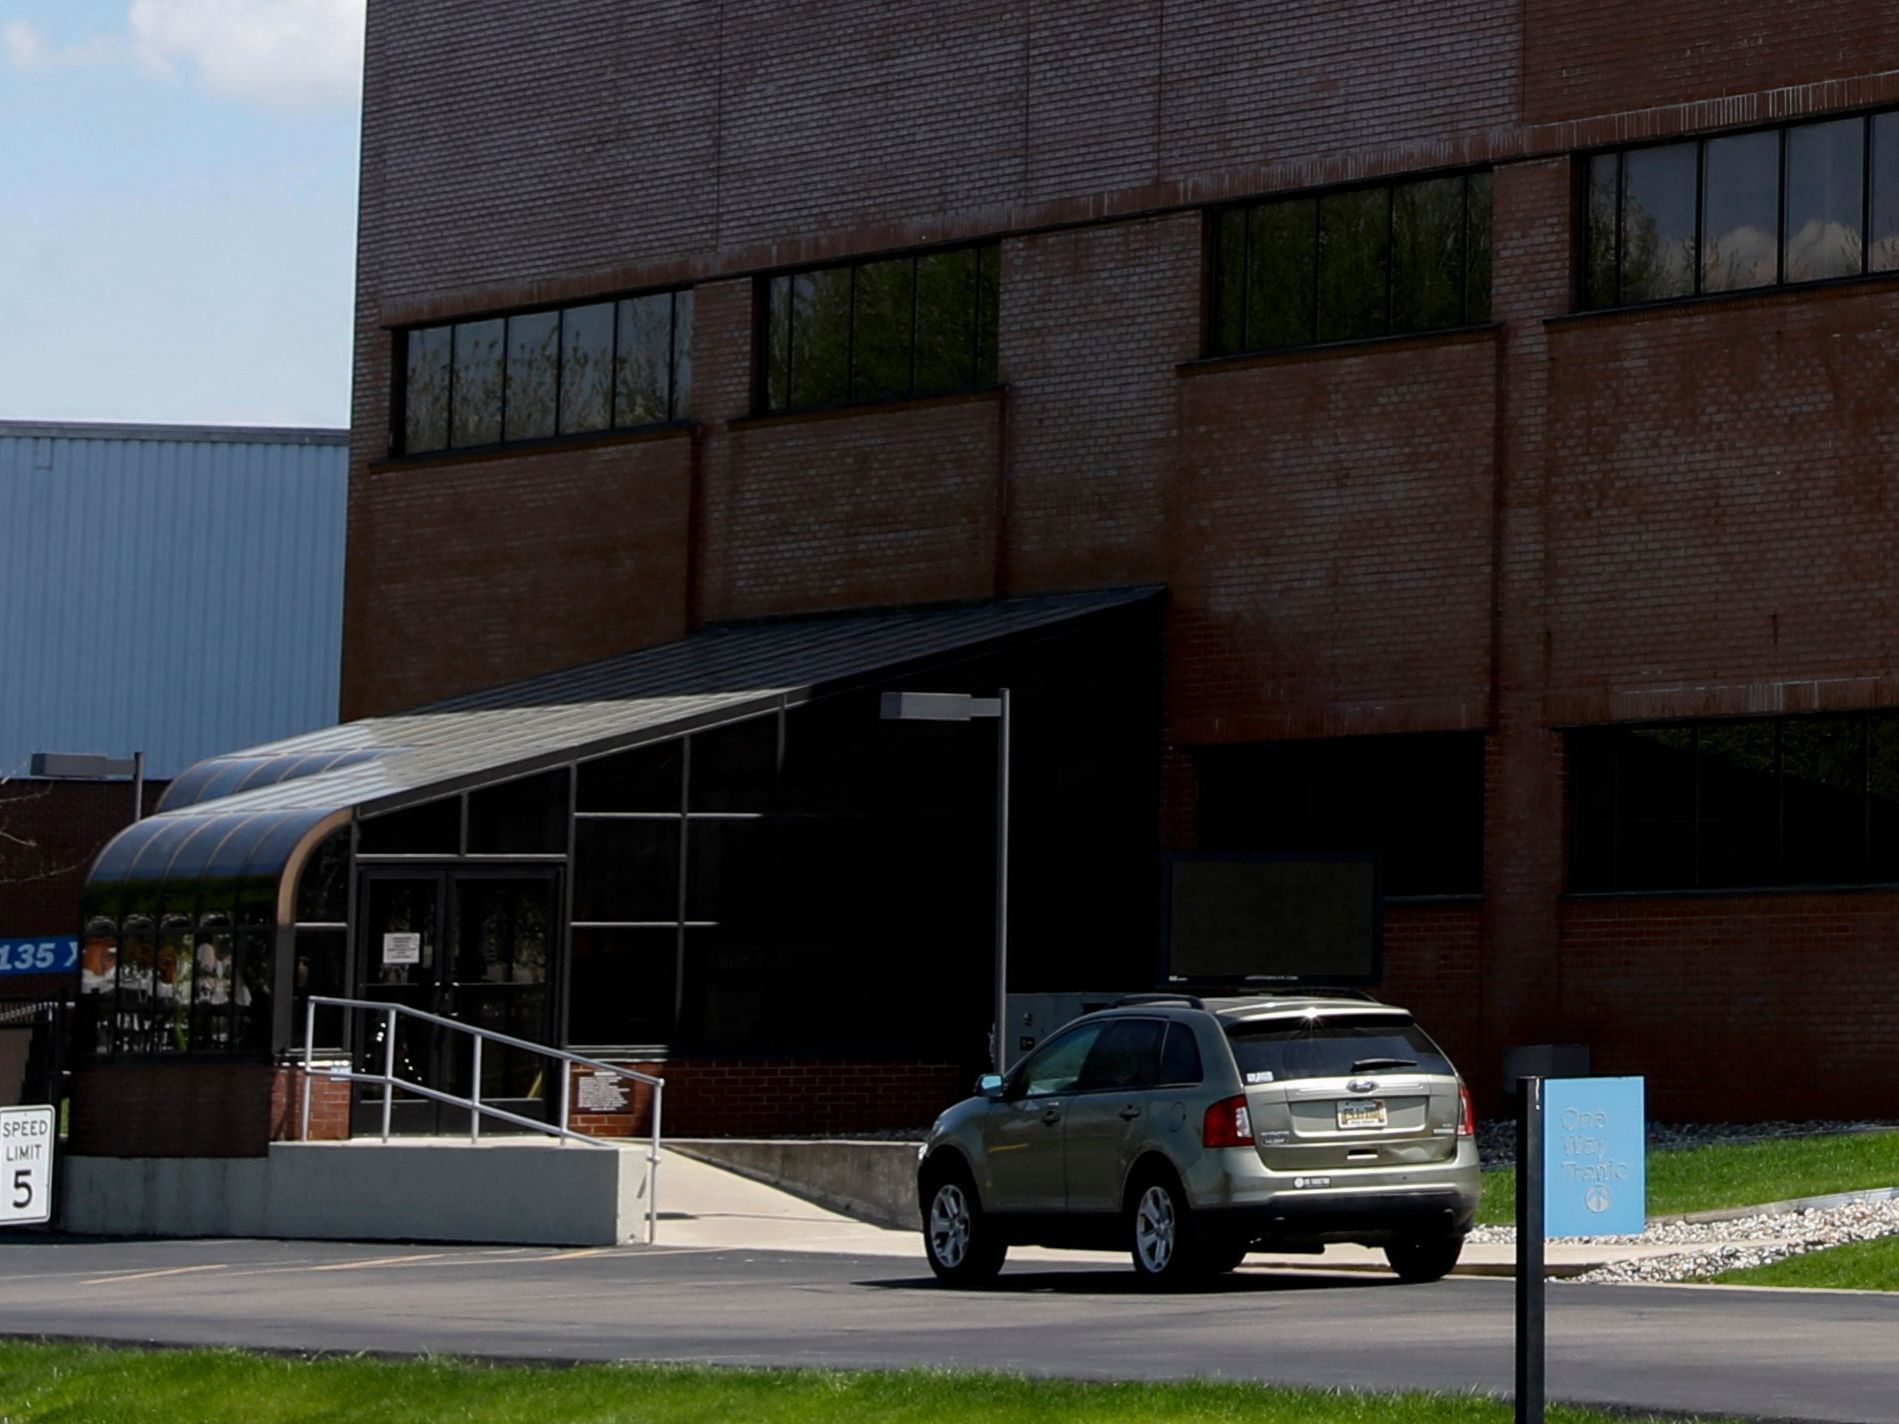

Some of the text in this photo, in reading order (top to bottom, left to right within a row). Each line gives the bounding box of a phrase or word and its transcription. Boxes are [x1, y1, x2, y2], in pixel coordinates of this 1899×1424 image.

[3, 1119, 48, 1138] SPEED
[1560, 1107, 1606, 1131] One
[6, 1144, 42, 1162] LIMIT
[12, 1169, 33, 1209] 5
